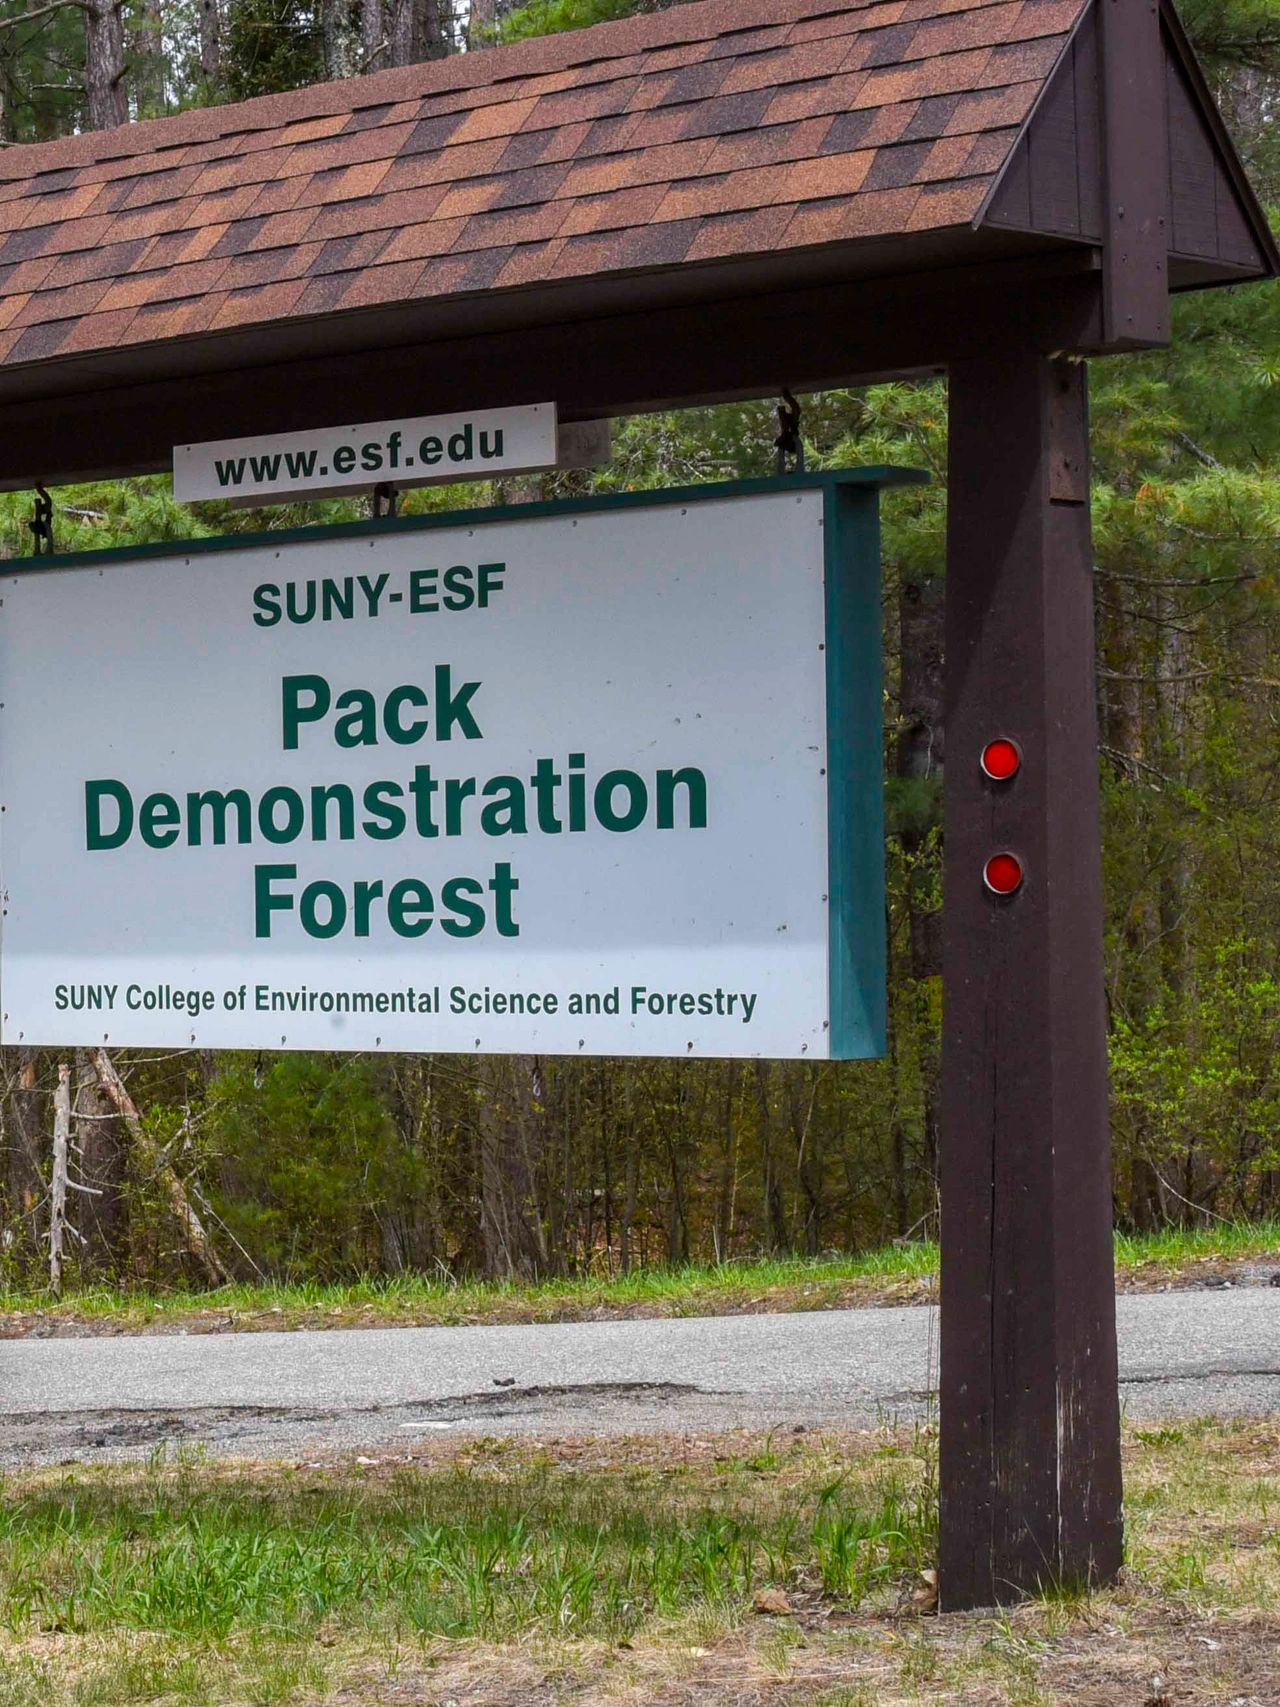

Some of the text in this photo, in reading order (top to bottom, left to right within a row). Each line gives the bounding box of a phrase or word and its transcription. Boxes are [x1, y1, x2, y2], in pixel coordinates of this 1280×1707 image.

[215, 425, 505, 487] www.esf.edu
[253, 562, 506, 627] SUNY-ESF
[282, 664, 483, 750] Pack
[85, 753, 708, 851] Demonstration
[255, 863, 520, 939] Forest
[55, 985, 758, 1024] SUNY College of Environmental Science and Forestry
